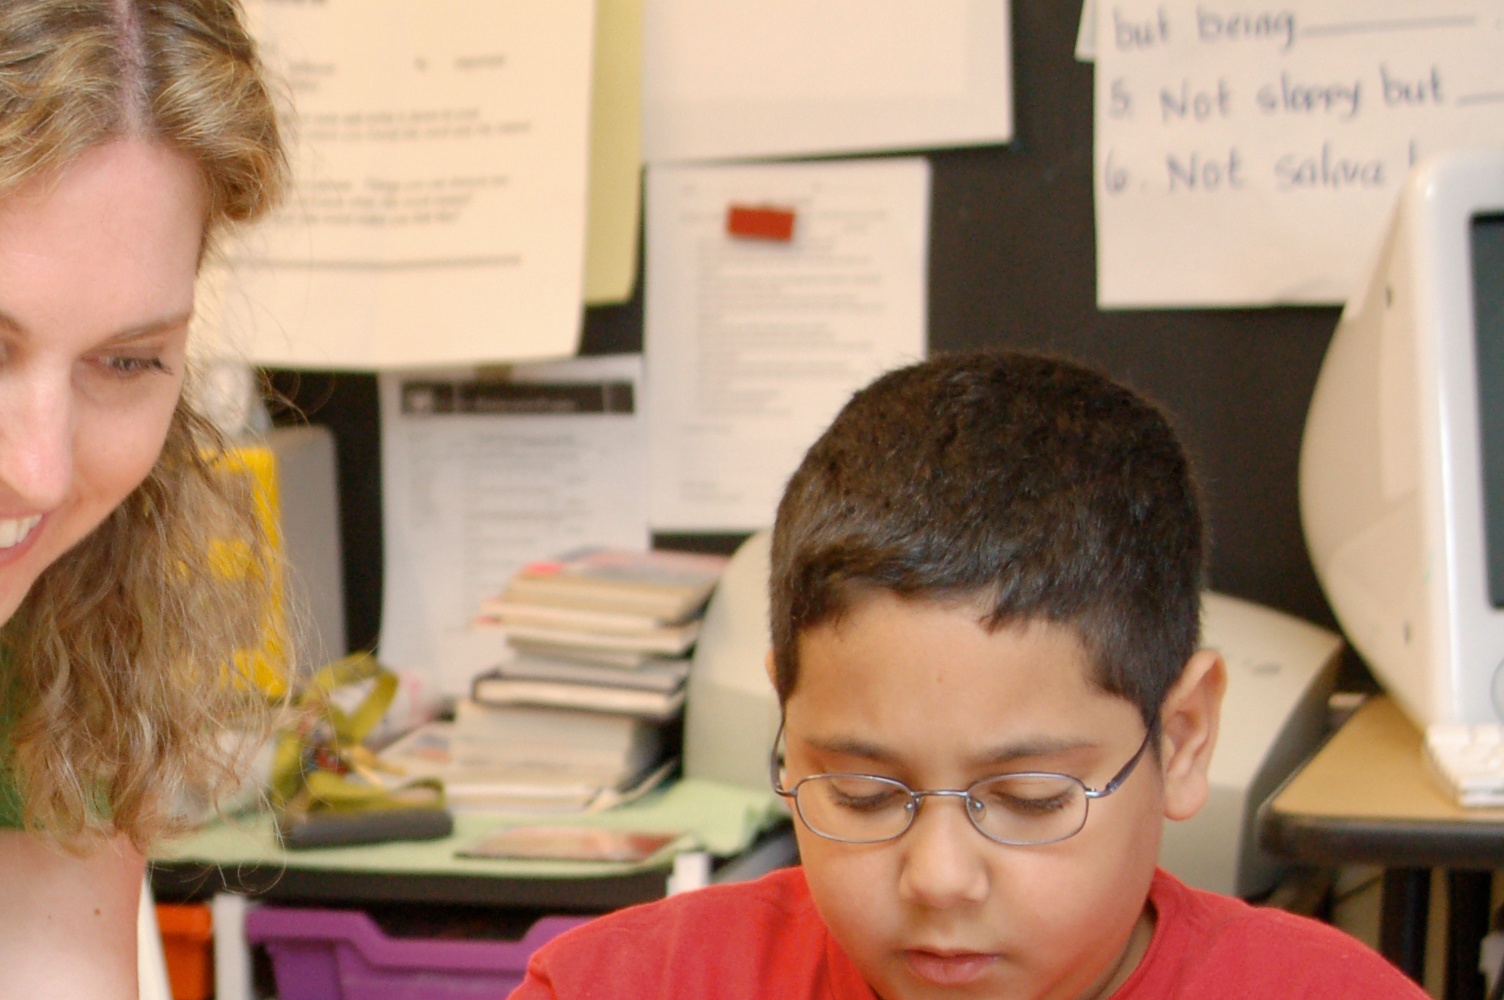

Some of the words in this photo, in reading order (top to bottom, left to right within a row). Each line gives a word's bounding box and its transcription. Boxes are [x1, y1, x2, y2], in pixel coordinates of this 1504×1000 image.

[1113, 5, 1170, 51] but
[1196, 4, 1296, 56] being
[1160, 79, 1233, 123] Not
[1380, 62, 1445, 107] but
[1166, 145, 1243, 194] Not
